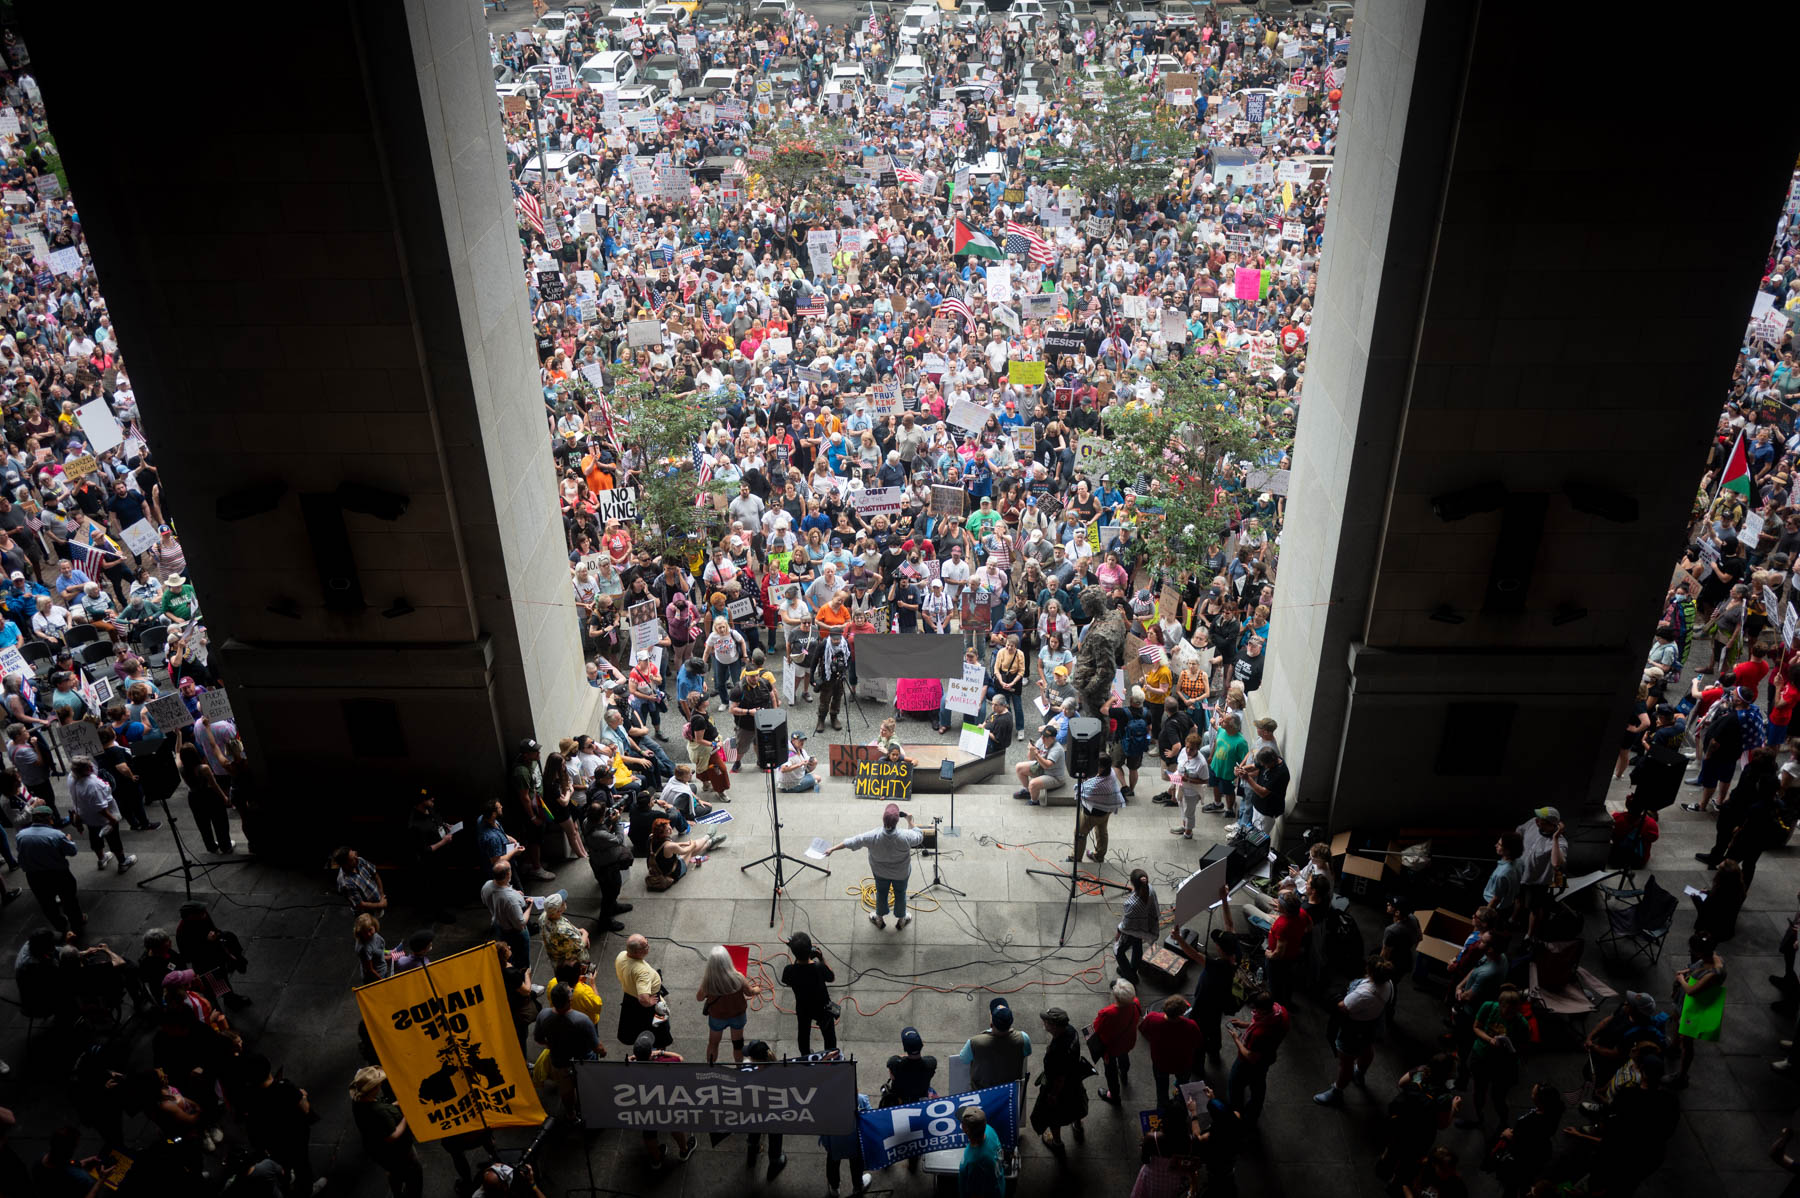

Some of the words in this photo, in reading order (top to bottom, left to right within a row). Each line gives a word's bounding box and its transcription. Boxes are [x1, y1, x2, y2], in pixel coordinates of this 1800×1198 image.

[1046, 337, 1081, 348] RESIST
[610, 488, 628, 503] NO
[603, 501, 635, 521] KING
[856, 503, 901, 513] CONSTITUTION
[729, 600, 748, 610] HANDS
[205, 692, 222, 701] FUCK
[950, 695, 977, 705] AMERICA
[210, 700, 225, 708] AND
[900, 699, 938, 709] RESISTANCE
[210, 708, 232, 718] BIRTH
[60, 725, 86, 738] Liberty
[840, 745, 869, 760] NO
[859, 763, 908, 776] MEIDAS
[856, 778, 911, 798] MIGHTY
